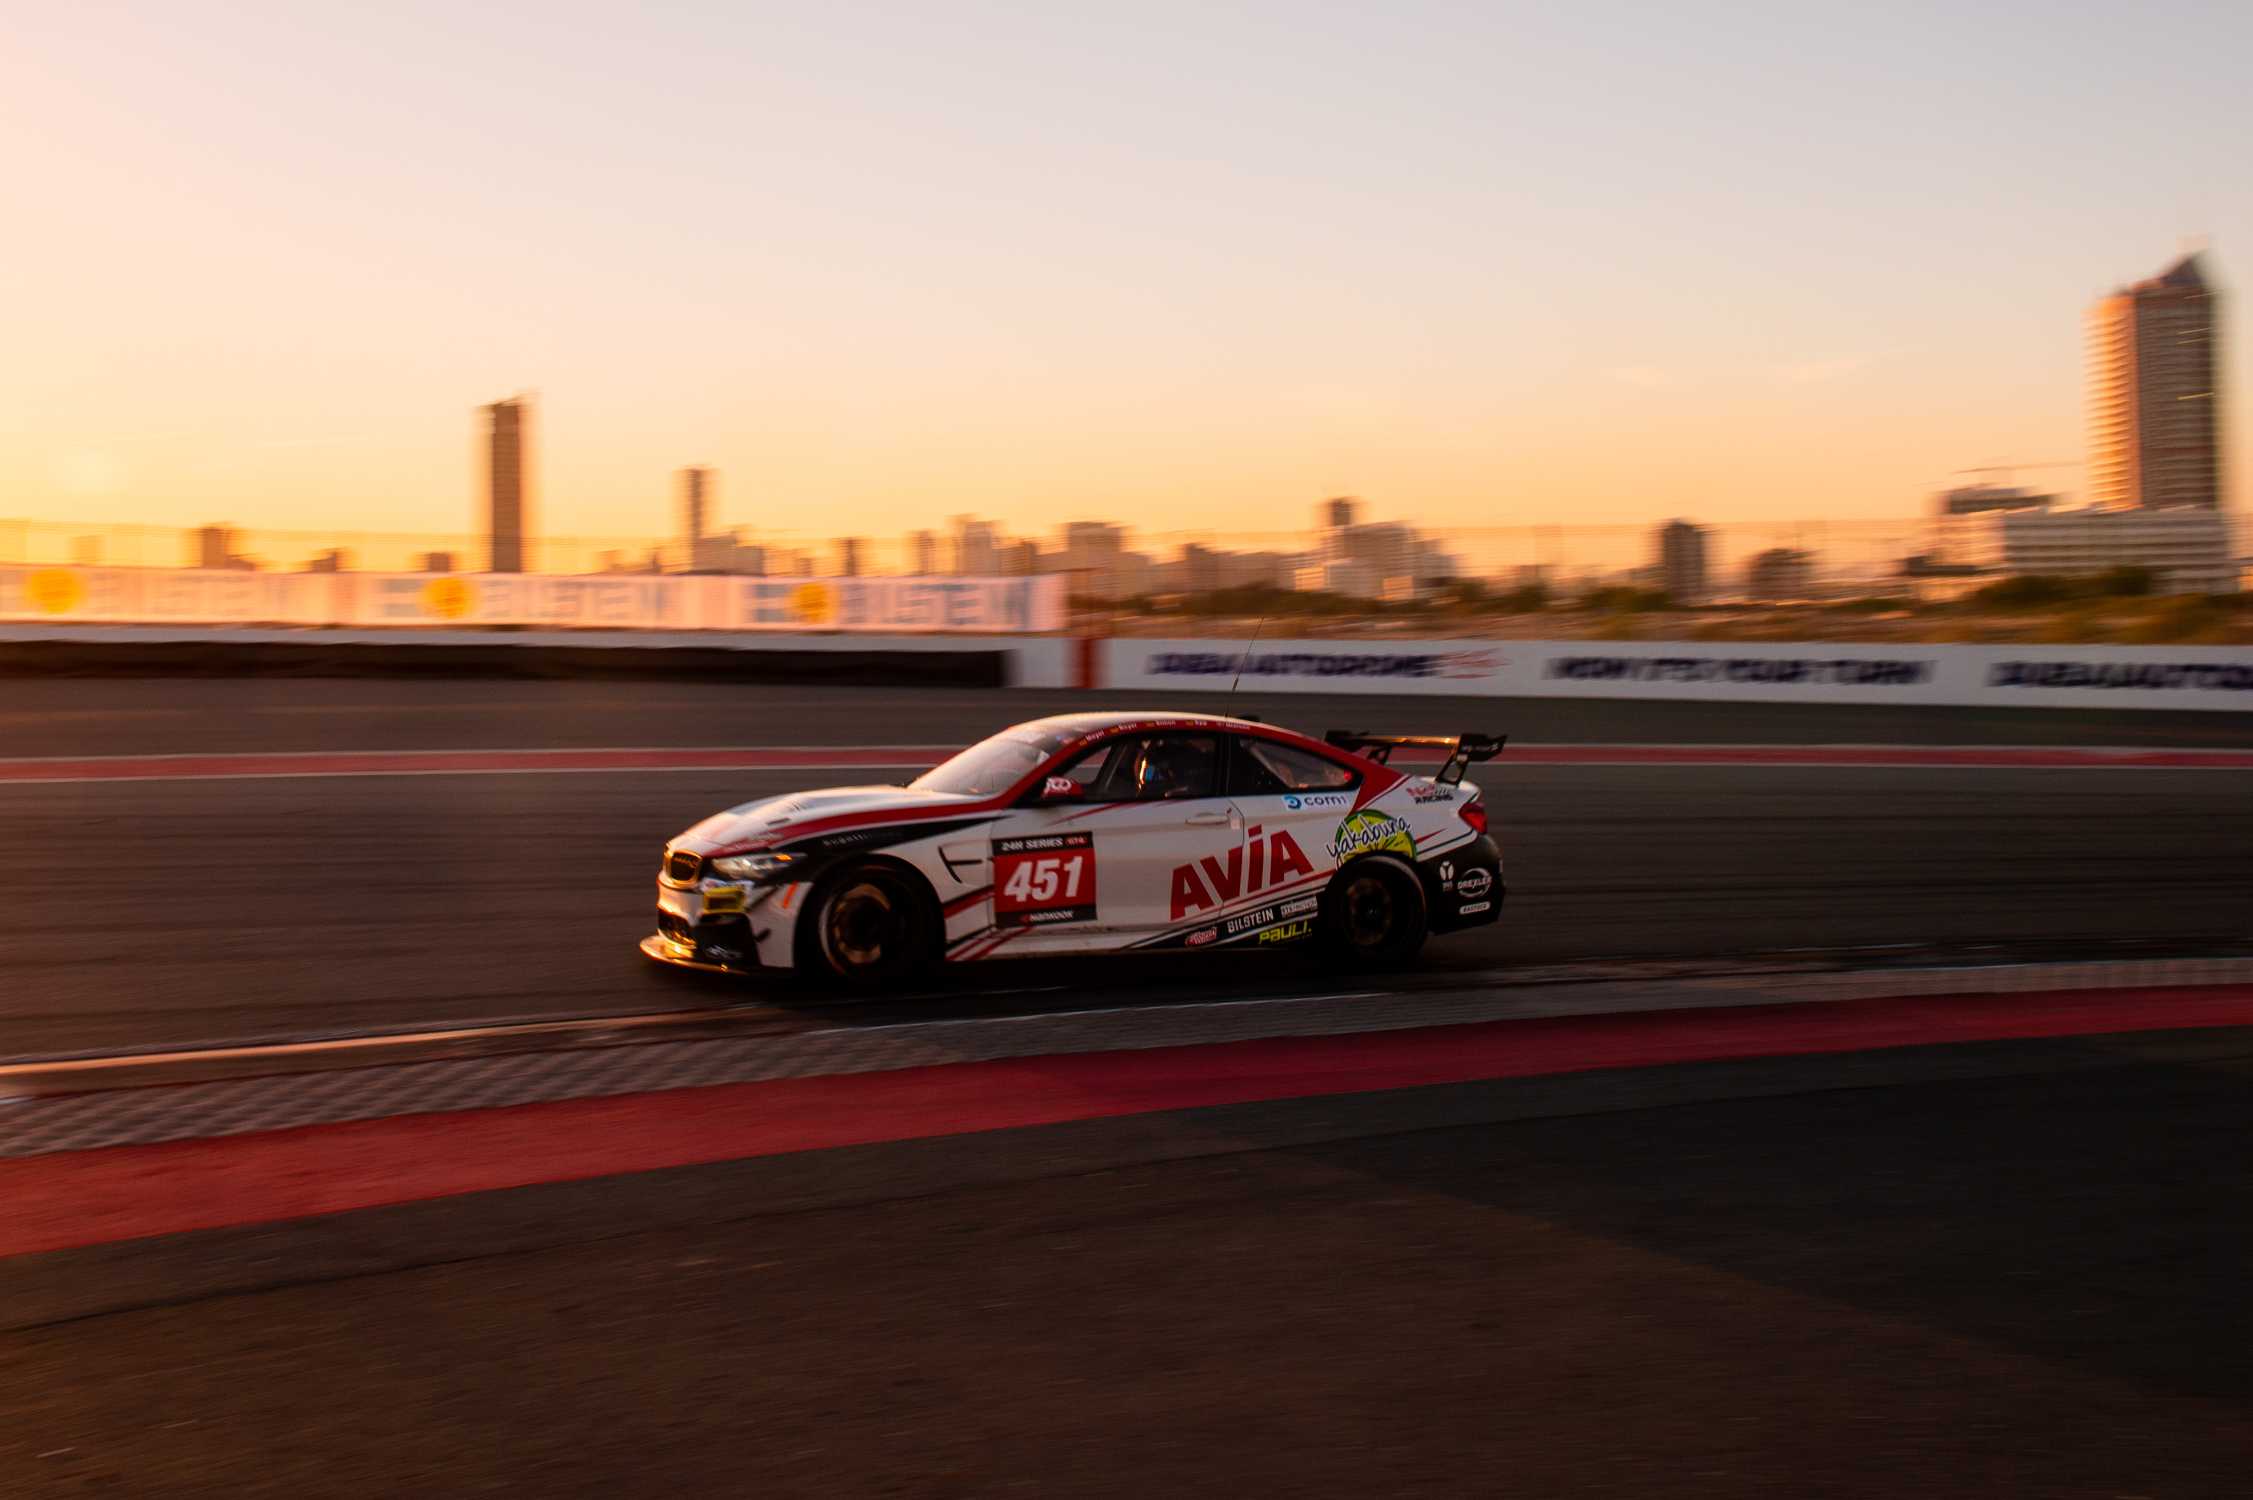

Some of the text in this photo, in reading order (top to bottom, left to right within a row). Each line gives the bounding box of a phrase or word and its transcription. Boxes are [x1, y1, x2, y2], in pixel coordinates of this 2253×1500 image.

[1026, 838, 1064, 849] SERIES
[1003, 856, 1083, 902] 451
[1169, 824, 1314, 921] AVIA
[1226, 908, 1274, 934] BILSTEIN
